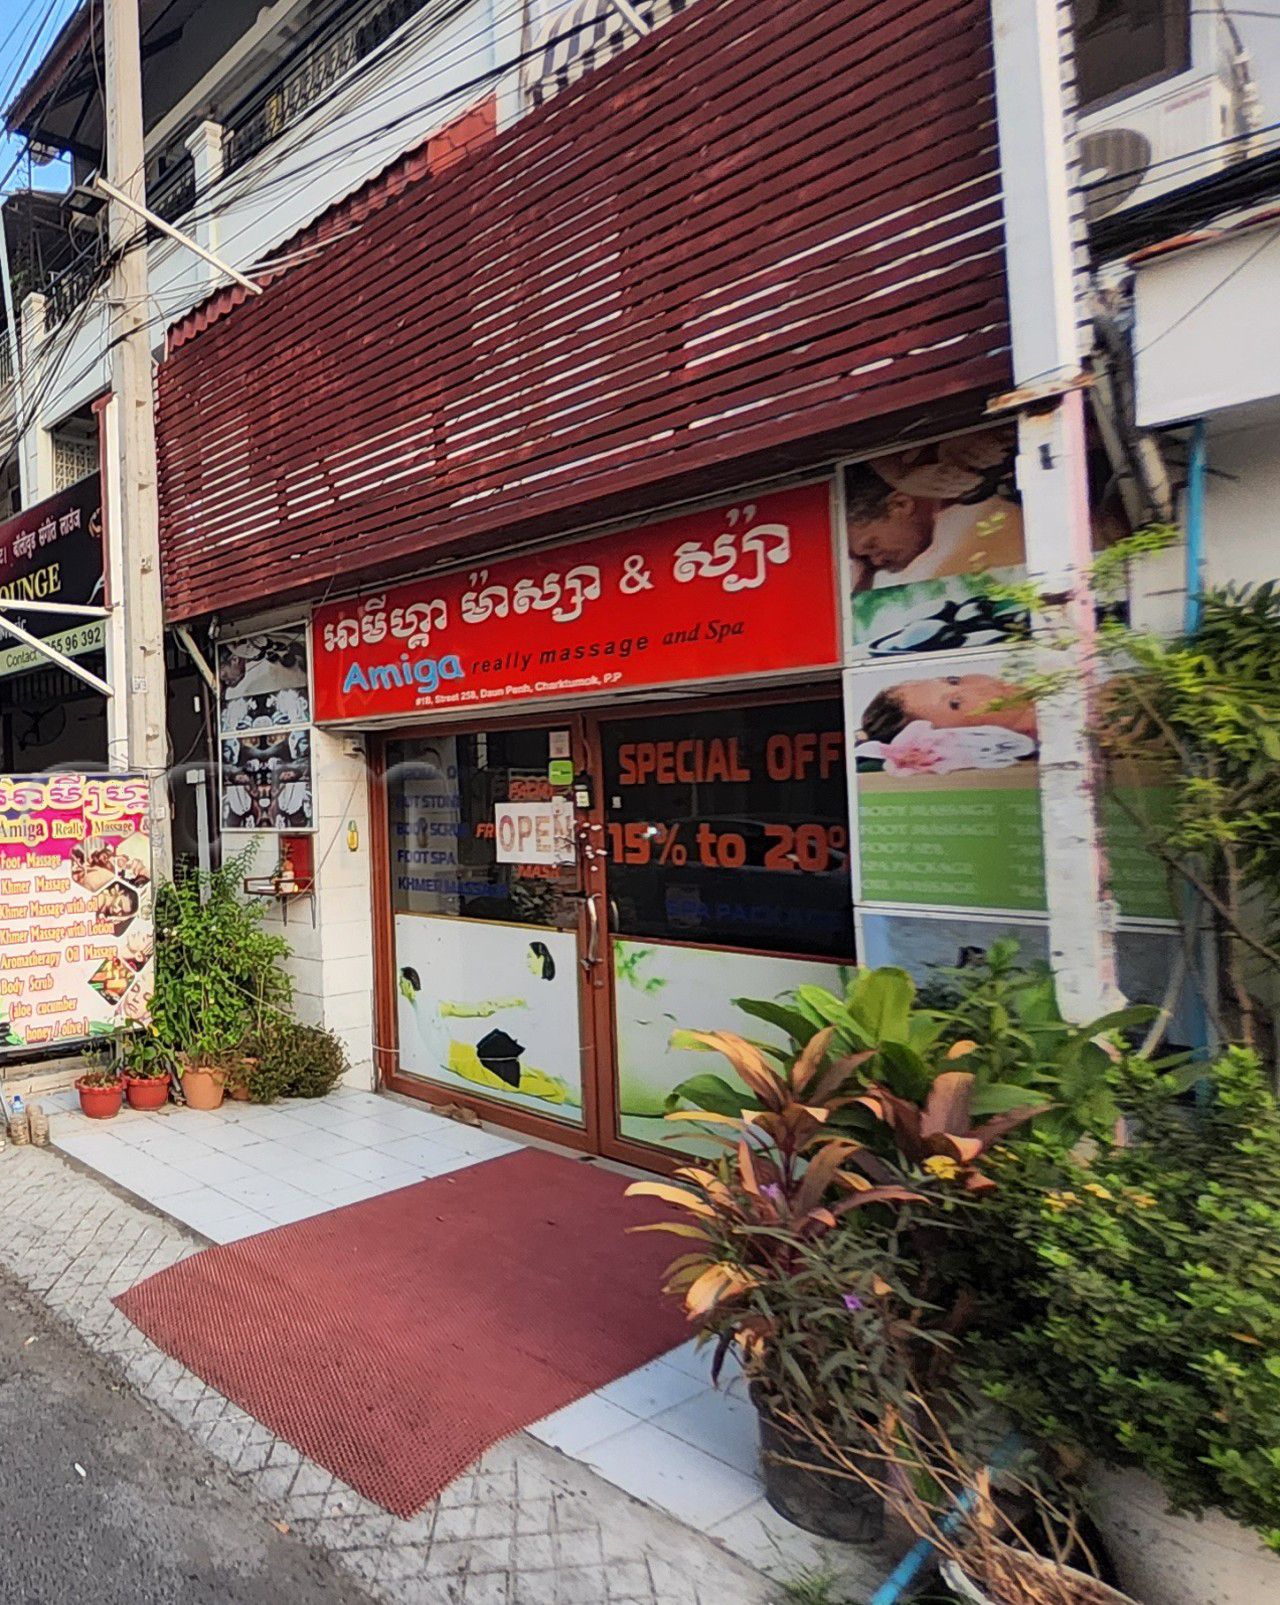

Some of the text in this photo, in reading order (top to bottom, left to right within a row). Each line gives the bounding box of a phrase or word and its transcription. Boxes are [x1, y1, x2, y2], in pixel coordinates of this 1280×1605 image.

[619, 554, 655, 595] &
[65, 634, 79, 652] 96
[80, 626, 101, 648] 392
[342, 620, 745, 694] Amiga really massage and Spa
[620, 736, 751, 784] SPECIAL
[55, 823, 84, 838] Really
[499, 814, 573, 853] OPEN
[609, 822, 687, 866] 15%
[697, 822, 746, 867] to
[26, 852, 62, 870] Massage
[431, 851, 456, 865] SPA
[1, 876, 71, 895] Khmer Massage
[29, 901, 65, 918] Massage
[66, 897, 85, 913] with
[0, 919, 115, 945] Khmer Massage with Lotion
[0, 944, 118, 970] Aromatherapy Oil Massage
[0, 974, 54, 995] Body Scrub
[36, 996, 77, 1015] cucumber
